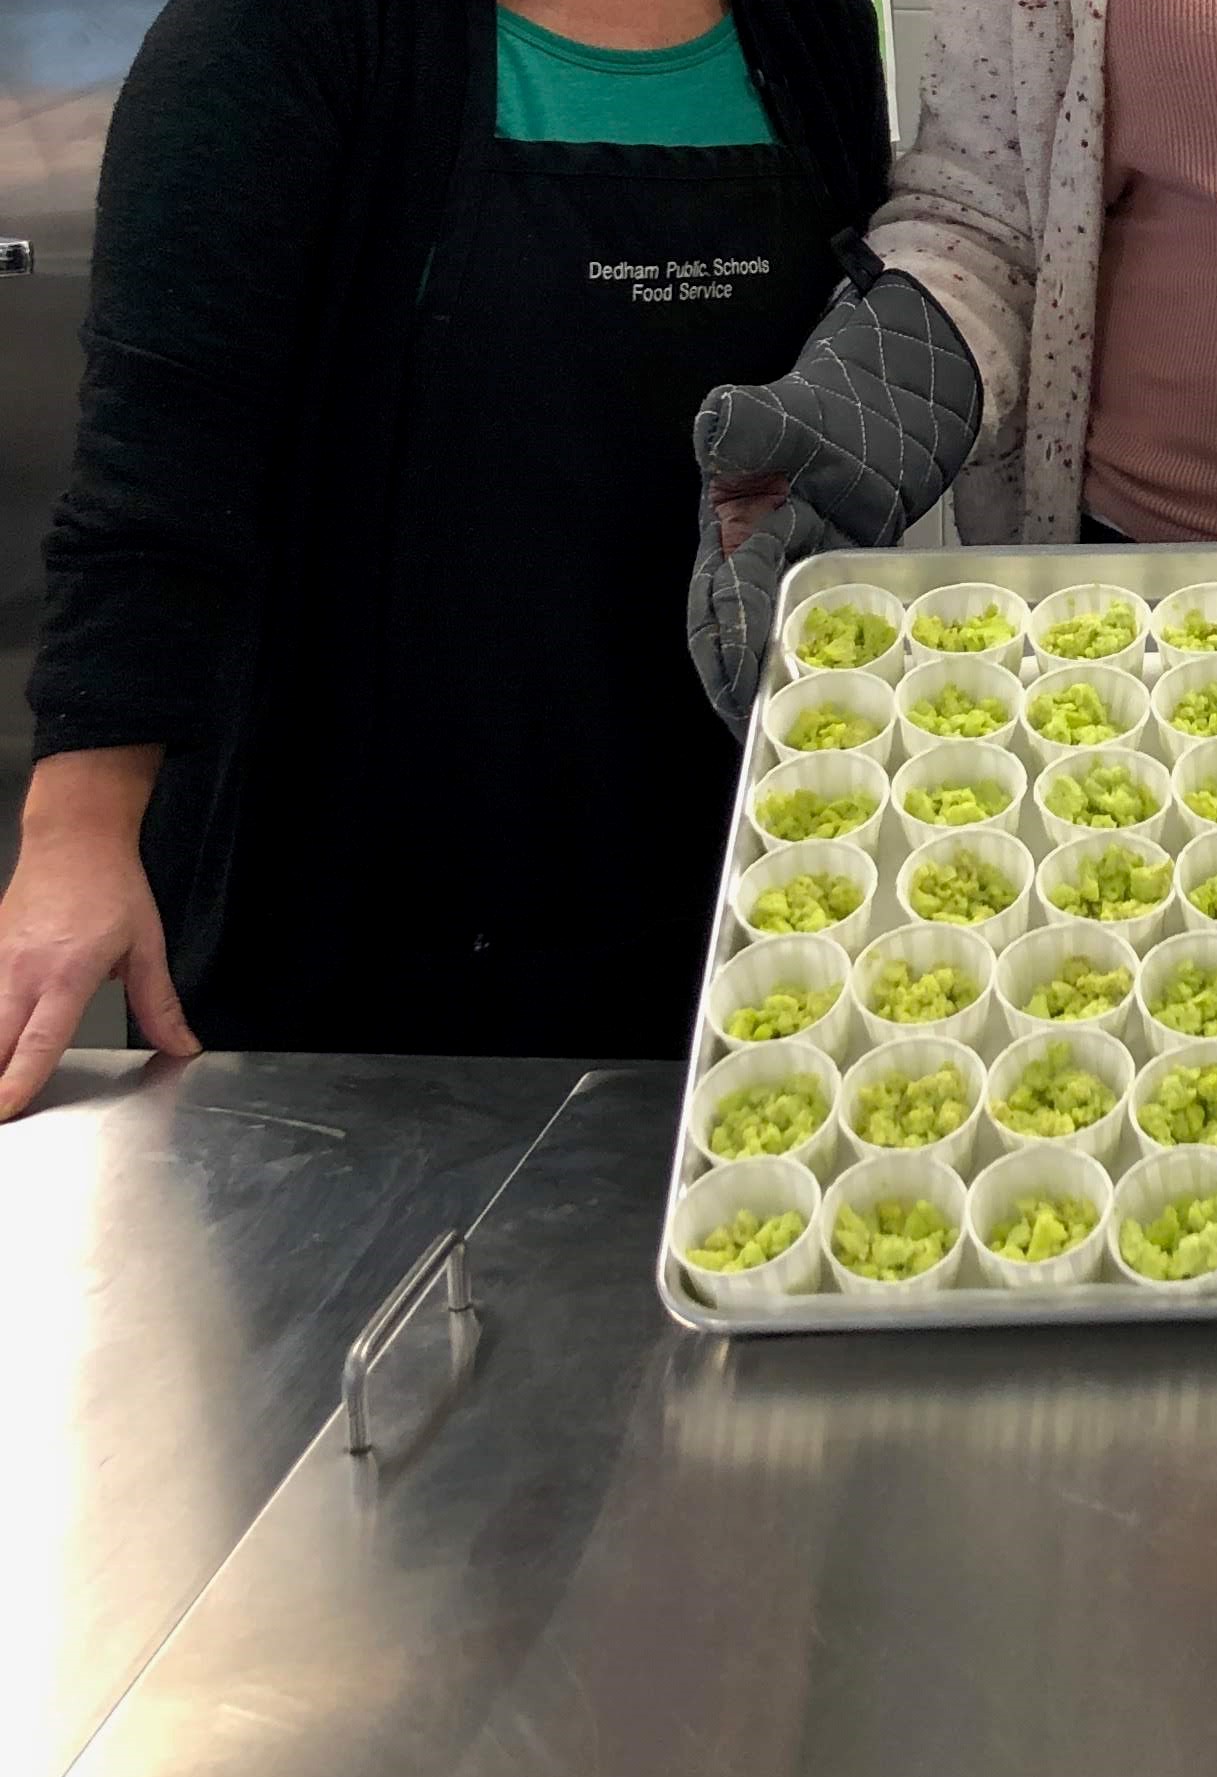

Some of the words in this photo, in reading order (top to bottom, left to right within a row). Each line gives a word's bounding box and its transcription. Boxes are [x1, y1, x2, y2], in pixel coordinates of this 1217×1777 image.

[589, 261, 660, 280] Dedham
[666, 260, 708, 279] Public
[712, 256, 770, 276] Schools
[632, 283, 673, 302] Food
[679, 280, 733, 301] Service
